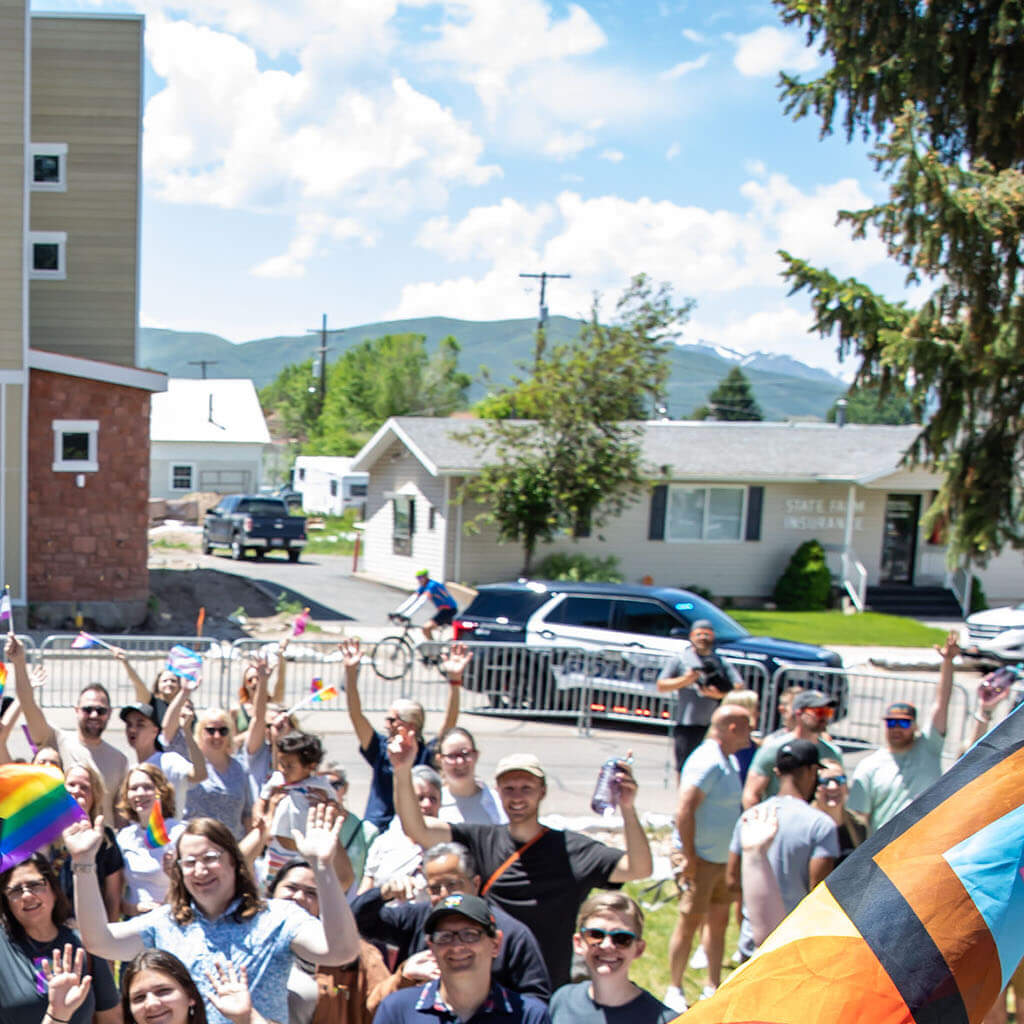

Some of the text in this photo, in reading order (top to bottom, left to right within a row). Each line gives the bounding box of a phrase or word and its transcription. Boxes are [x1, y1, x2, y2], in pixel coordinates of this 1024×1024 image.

[785, 499, 865, 513] STATE FAM
[784, 516, 864, 531] INSURANE
[561, 658, 663, 683] POLIC
